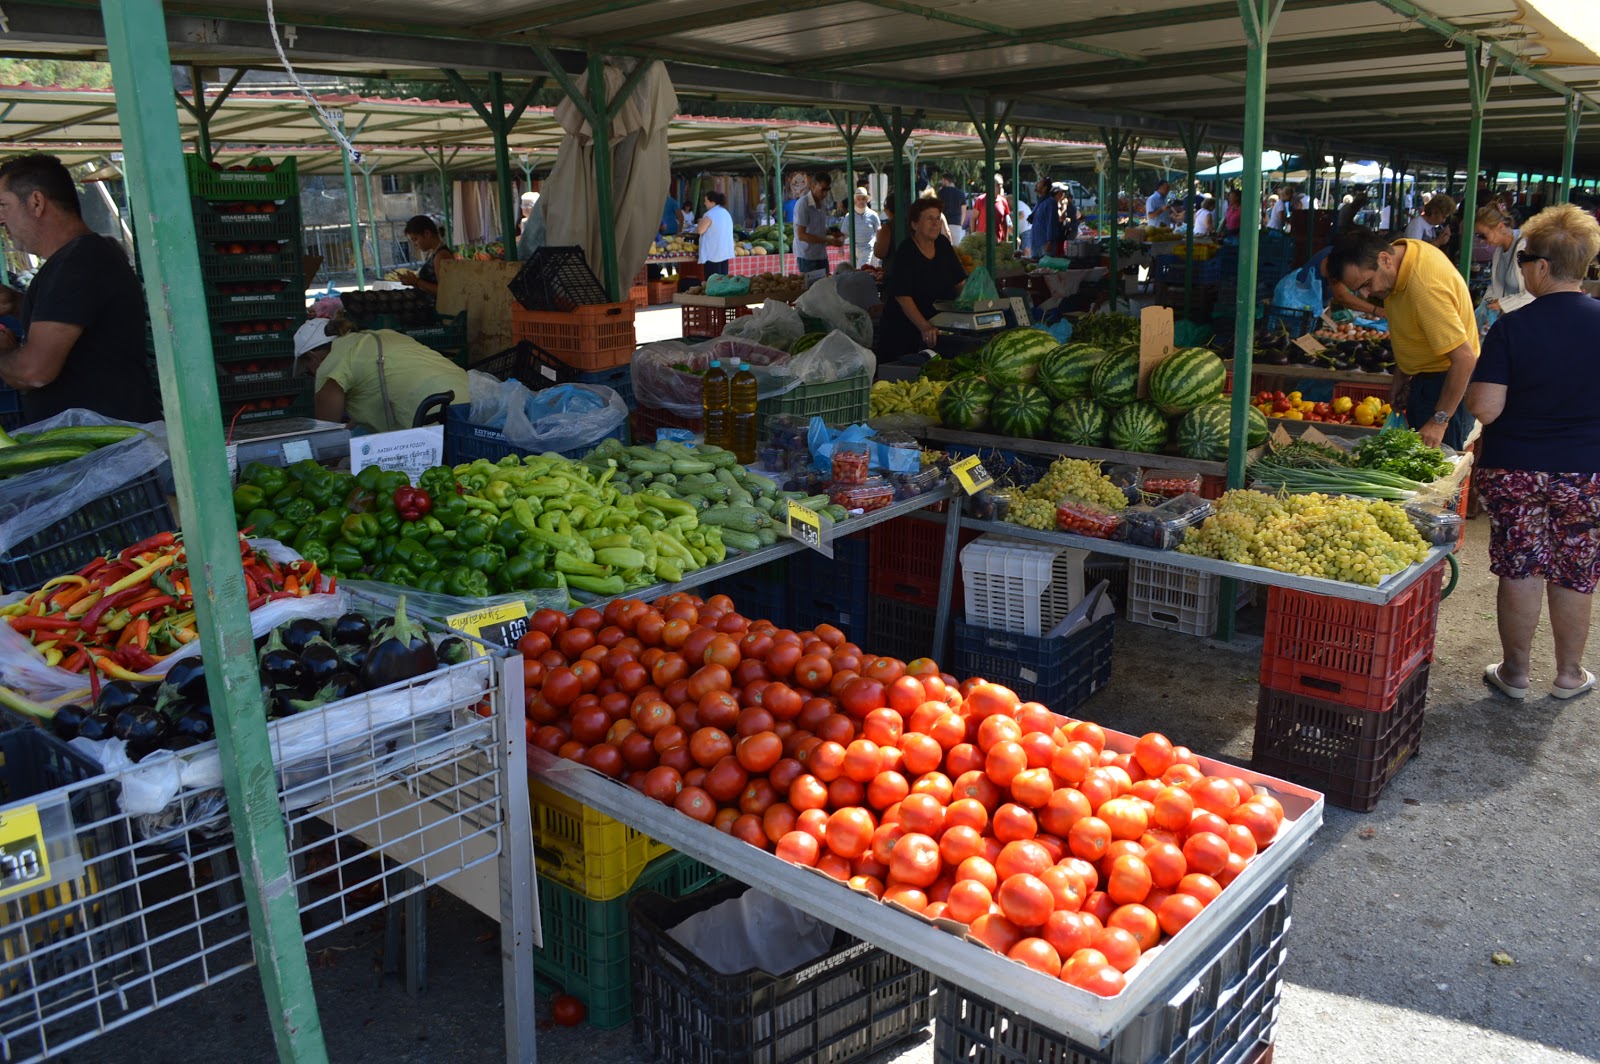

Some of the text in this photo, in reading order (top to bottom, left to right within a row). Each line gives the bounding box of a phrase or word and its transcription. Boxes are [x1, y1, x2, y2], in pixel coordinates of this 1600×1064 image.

[328, 111, 343, 119] 110
[795, 941, 870, 981] ΓΕΝΙΚΗ ΕΜΠΟΡΙΚΗ
